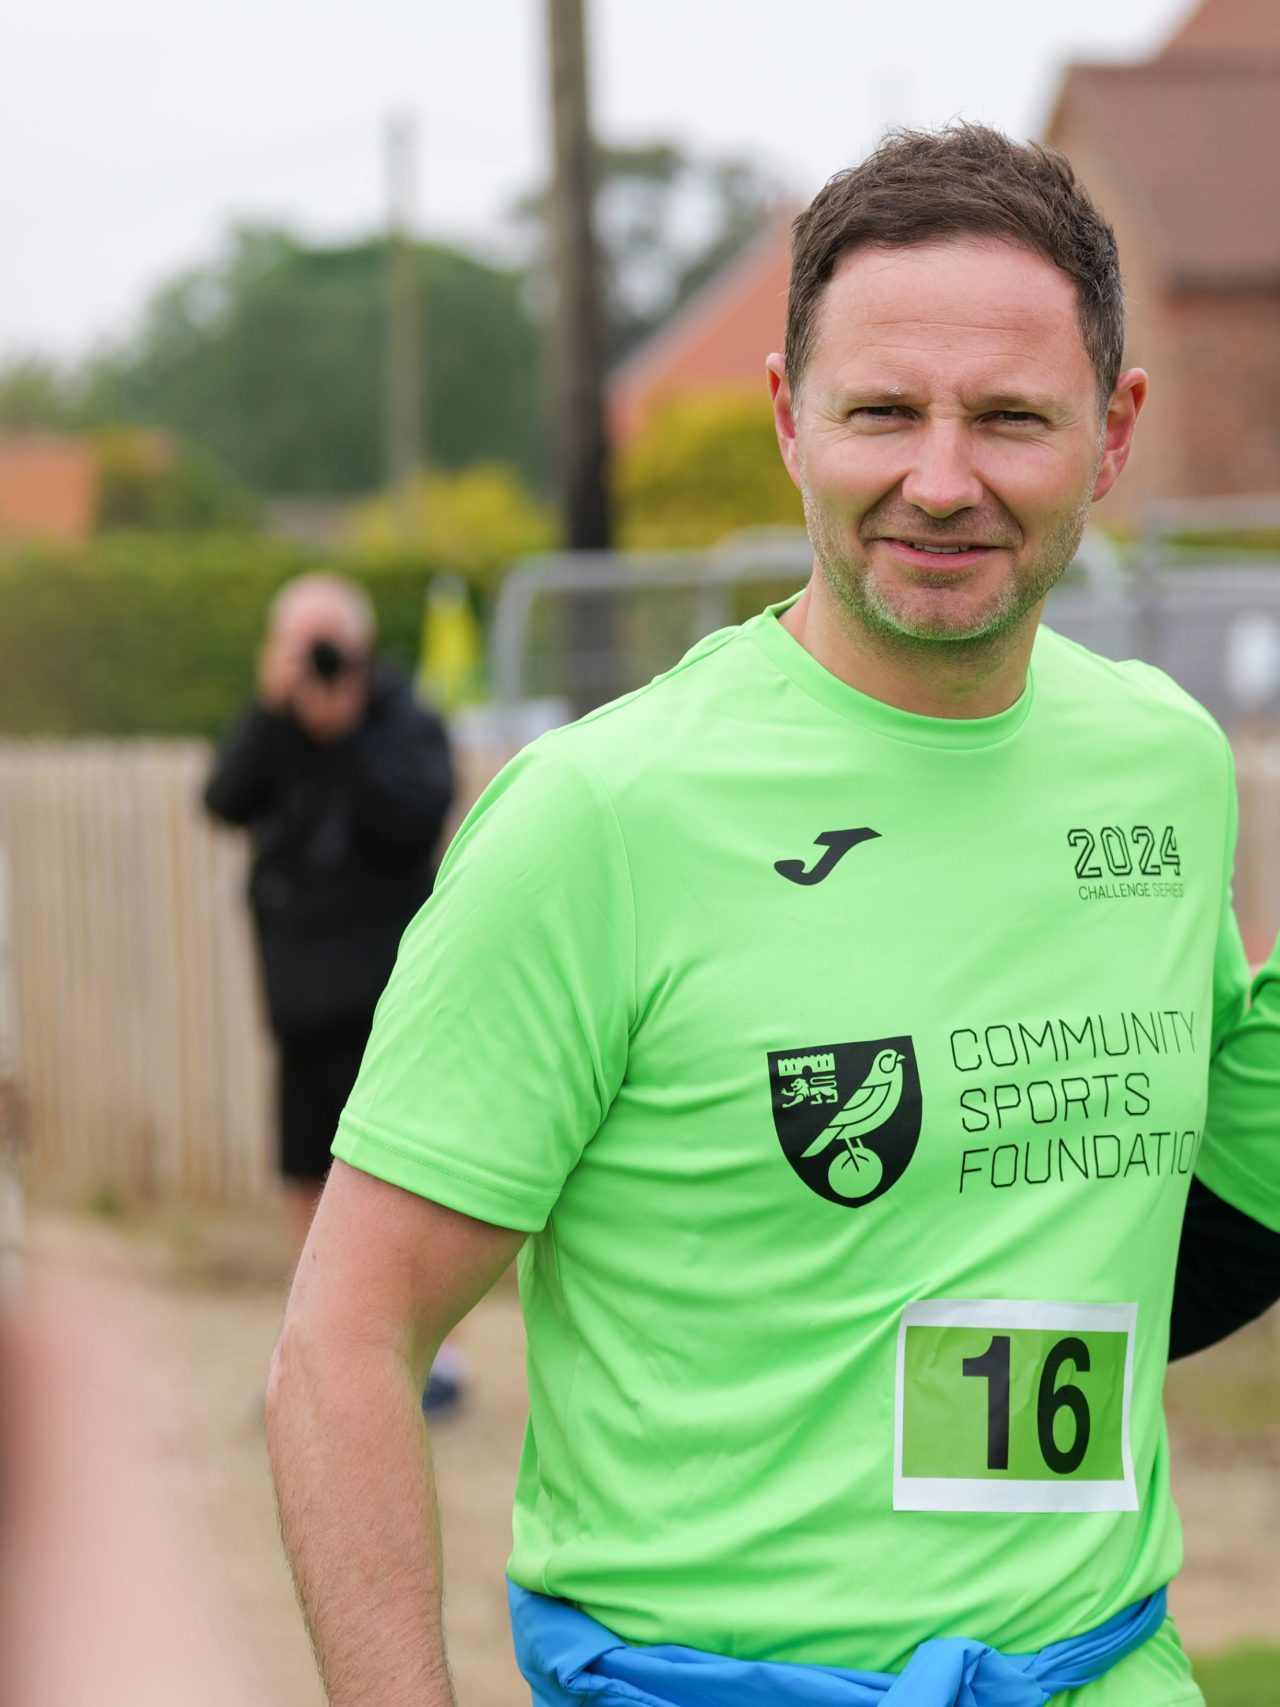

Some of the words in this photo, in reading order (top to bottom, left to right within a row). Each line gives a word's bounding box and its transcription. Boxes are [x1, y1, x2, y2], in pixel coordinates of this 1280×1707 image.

[1067, 825, 1181, 879] 2024
[1078, 882, 1151, 900] CHALLENGE
[1152, 882, 1184, 898] SERIES
[950, 1010, 1196, 1072] COMMUNITY
[960, 1072, 1150, 1133] SPORTS
[959, 1130, 1201, 1194] FOUNDATIO
[962, 1335, 1091, 1475] 16
